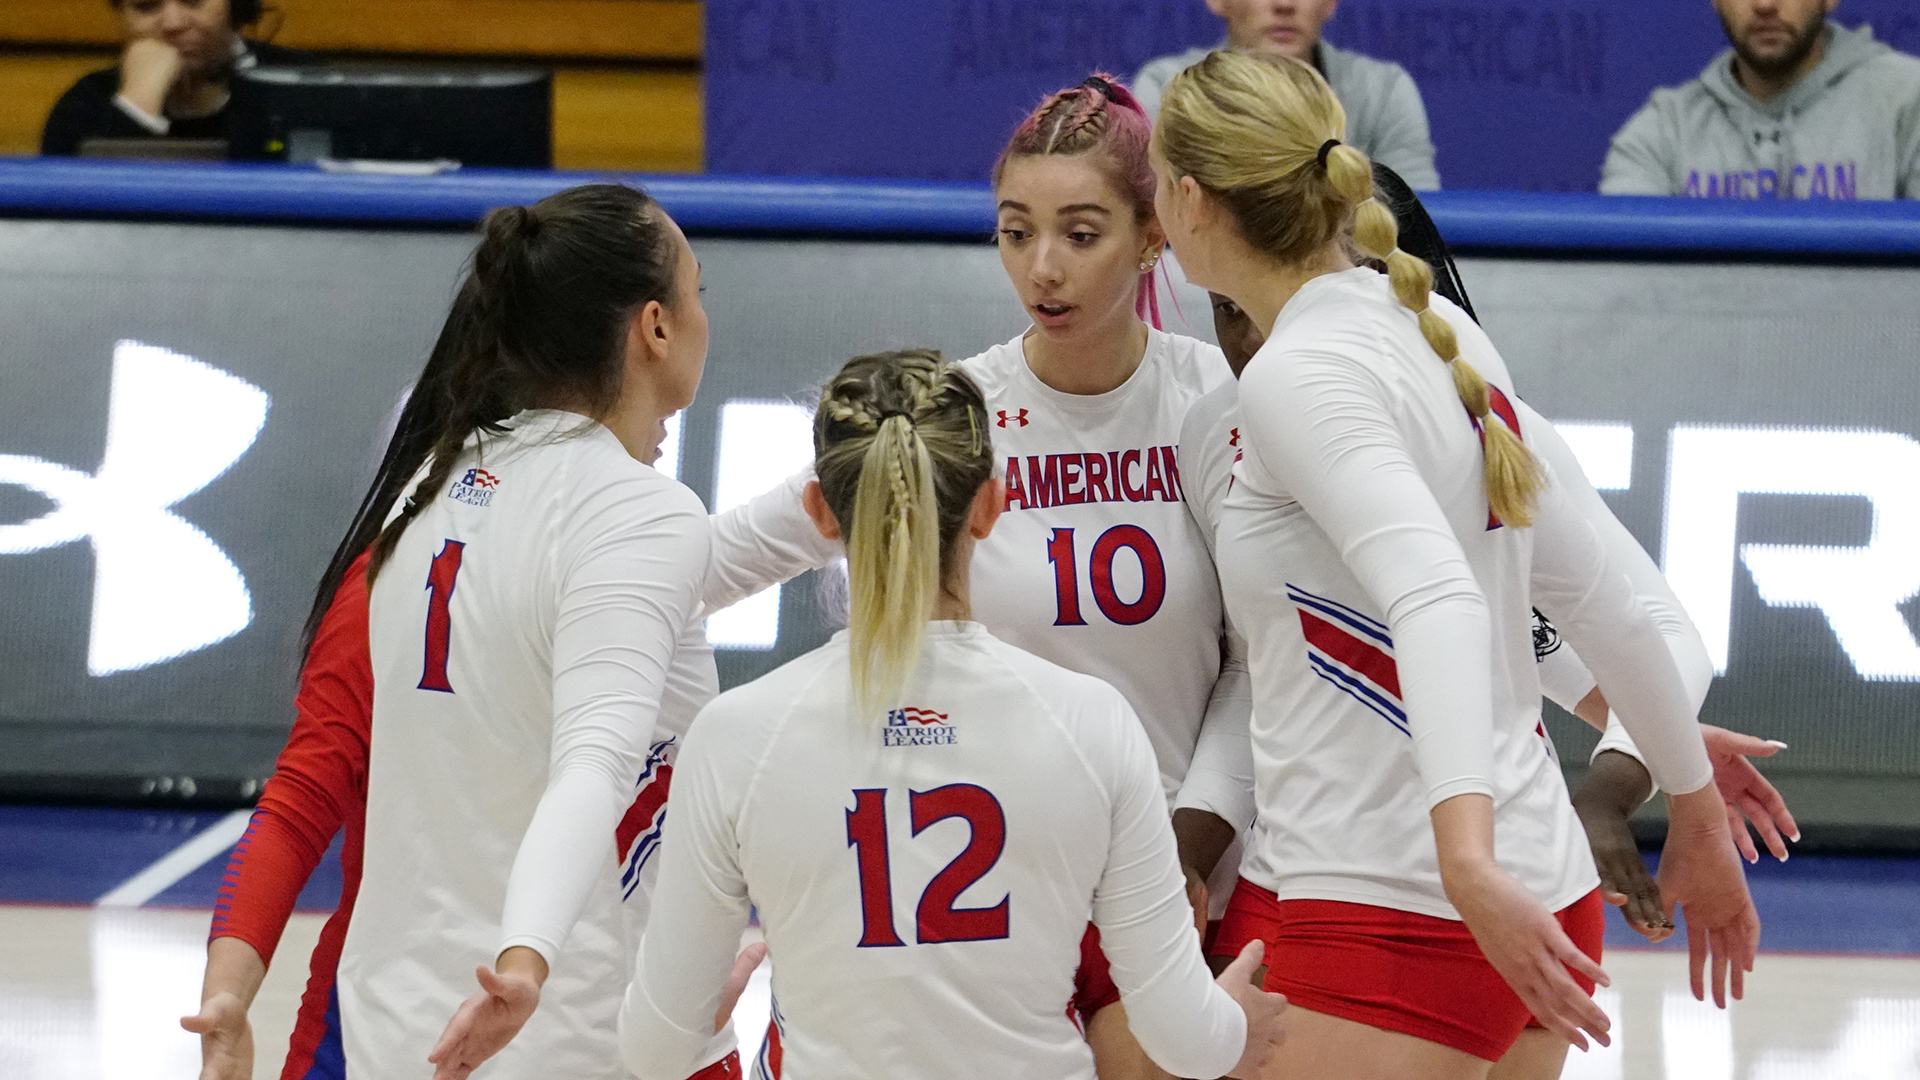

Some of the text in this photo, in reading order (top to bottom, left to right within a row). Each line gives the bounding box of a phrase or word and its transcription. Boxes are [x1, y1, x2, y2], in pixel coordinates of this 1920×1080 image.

[1685, 159, 1857, 200] AMERCAN
[1001, 445, 1189, 513] AMERICAN
[1046, 523, 1167, 626] 10
[416, 538, 467, 694] 1
[883, 726, 957, 739] PATRIOT
[884, 736, 958, 747] LEAGUE
[845, 782, 1010, 948] 12
